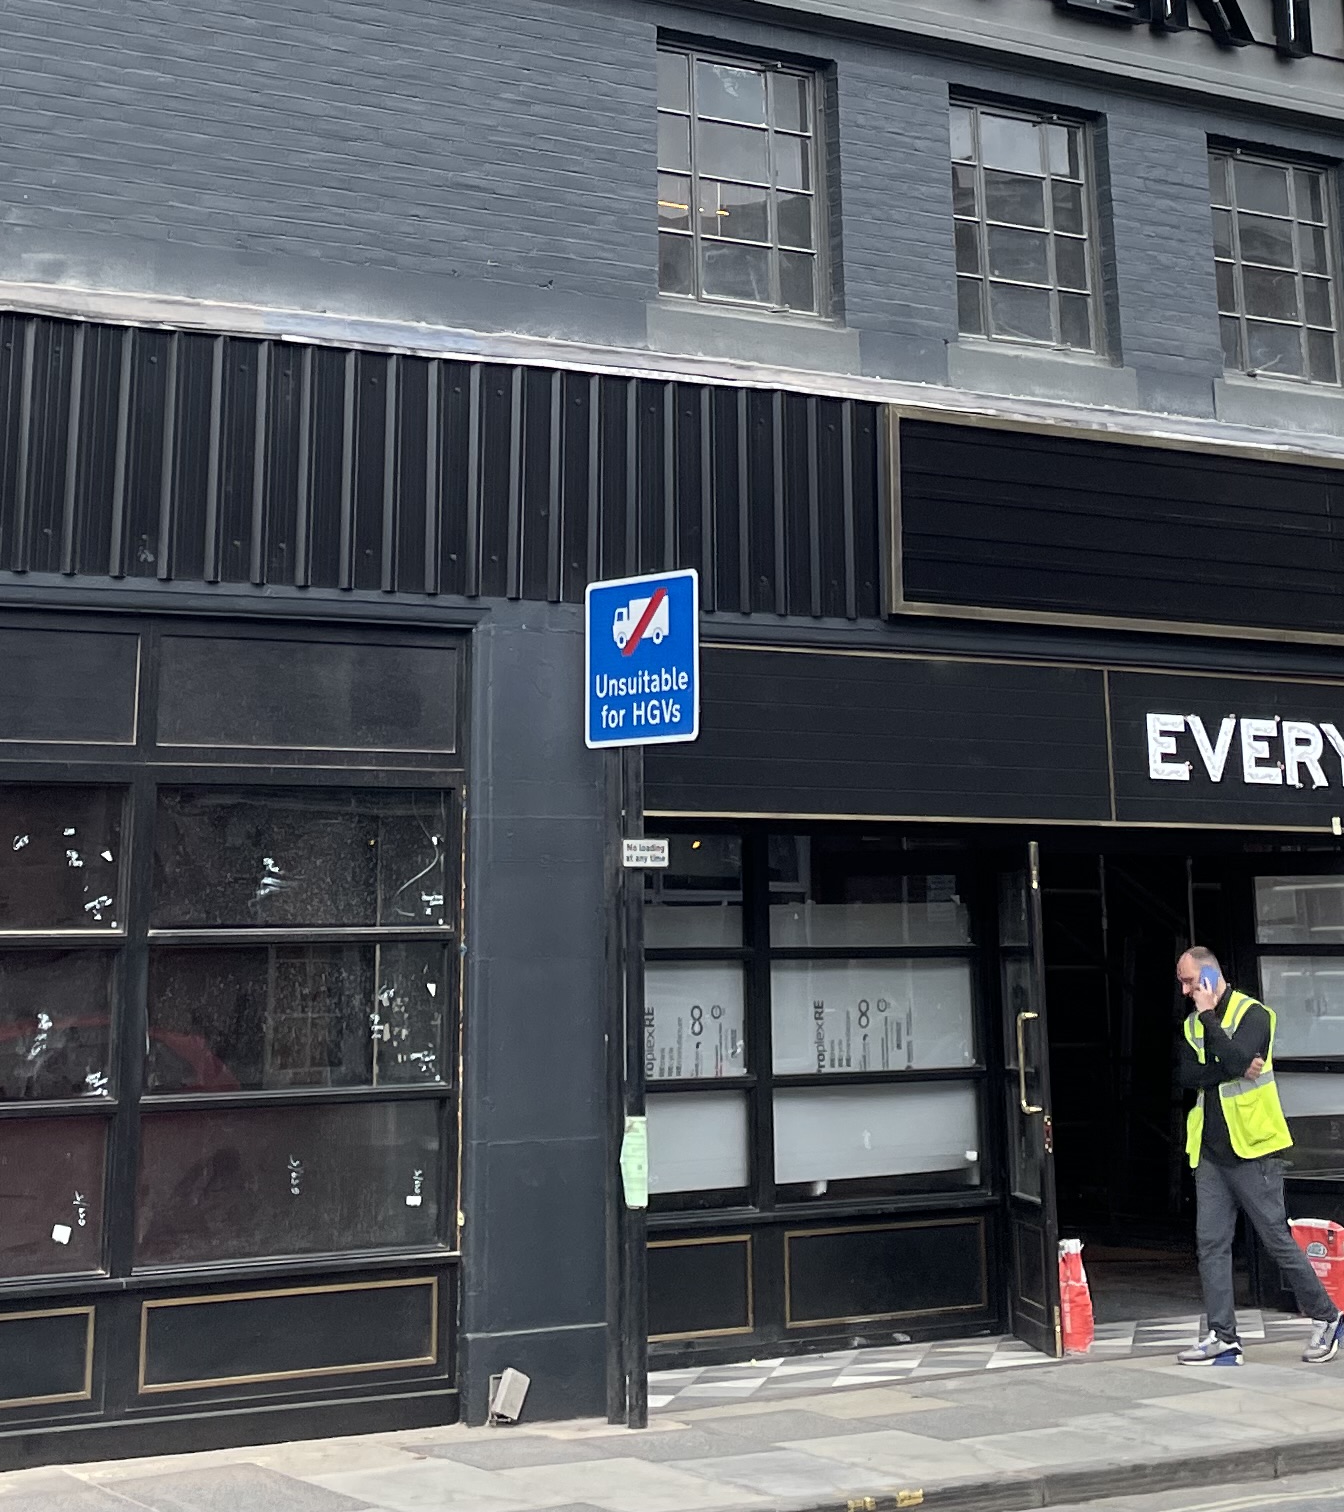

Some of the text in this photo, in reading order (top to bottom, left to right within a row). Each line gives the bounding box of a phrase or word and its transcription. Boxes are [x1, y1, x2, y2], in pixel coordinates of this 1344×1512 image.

[595, 666, 689, 698] Unsuitable
[601, 698, 682, 728] for HGVs
[626, 843, 665, 854] No loading
